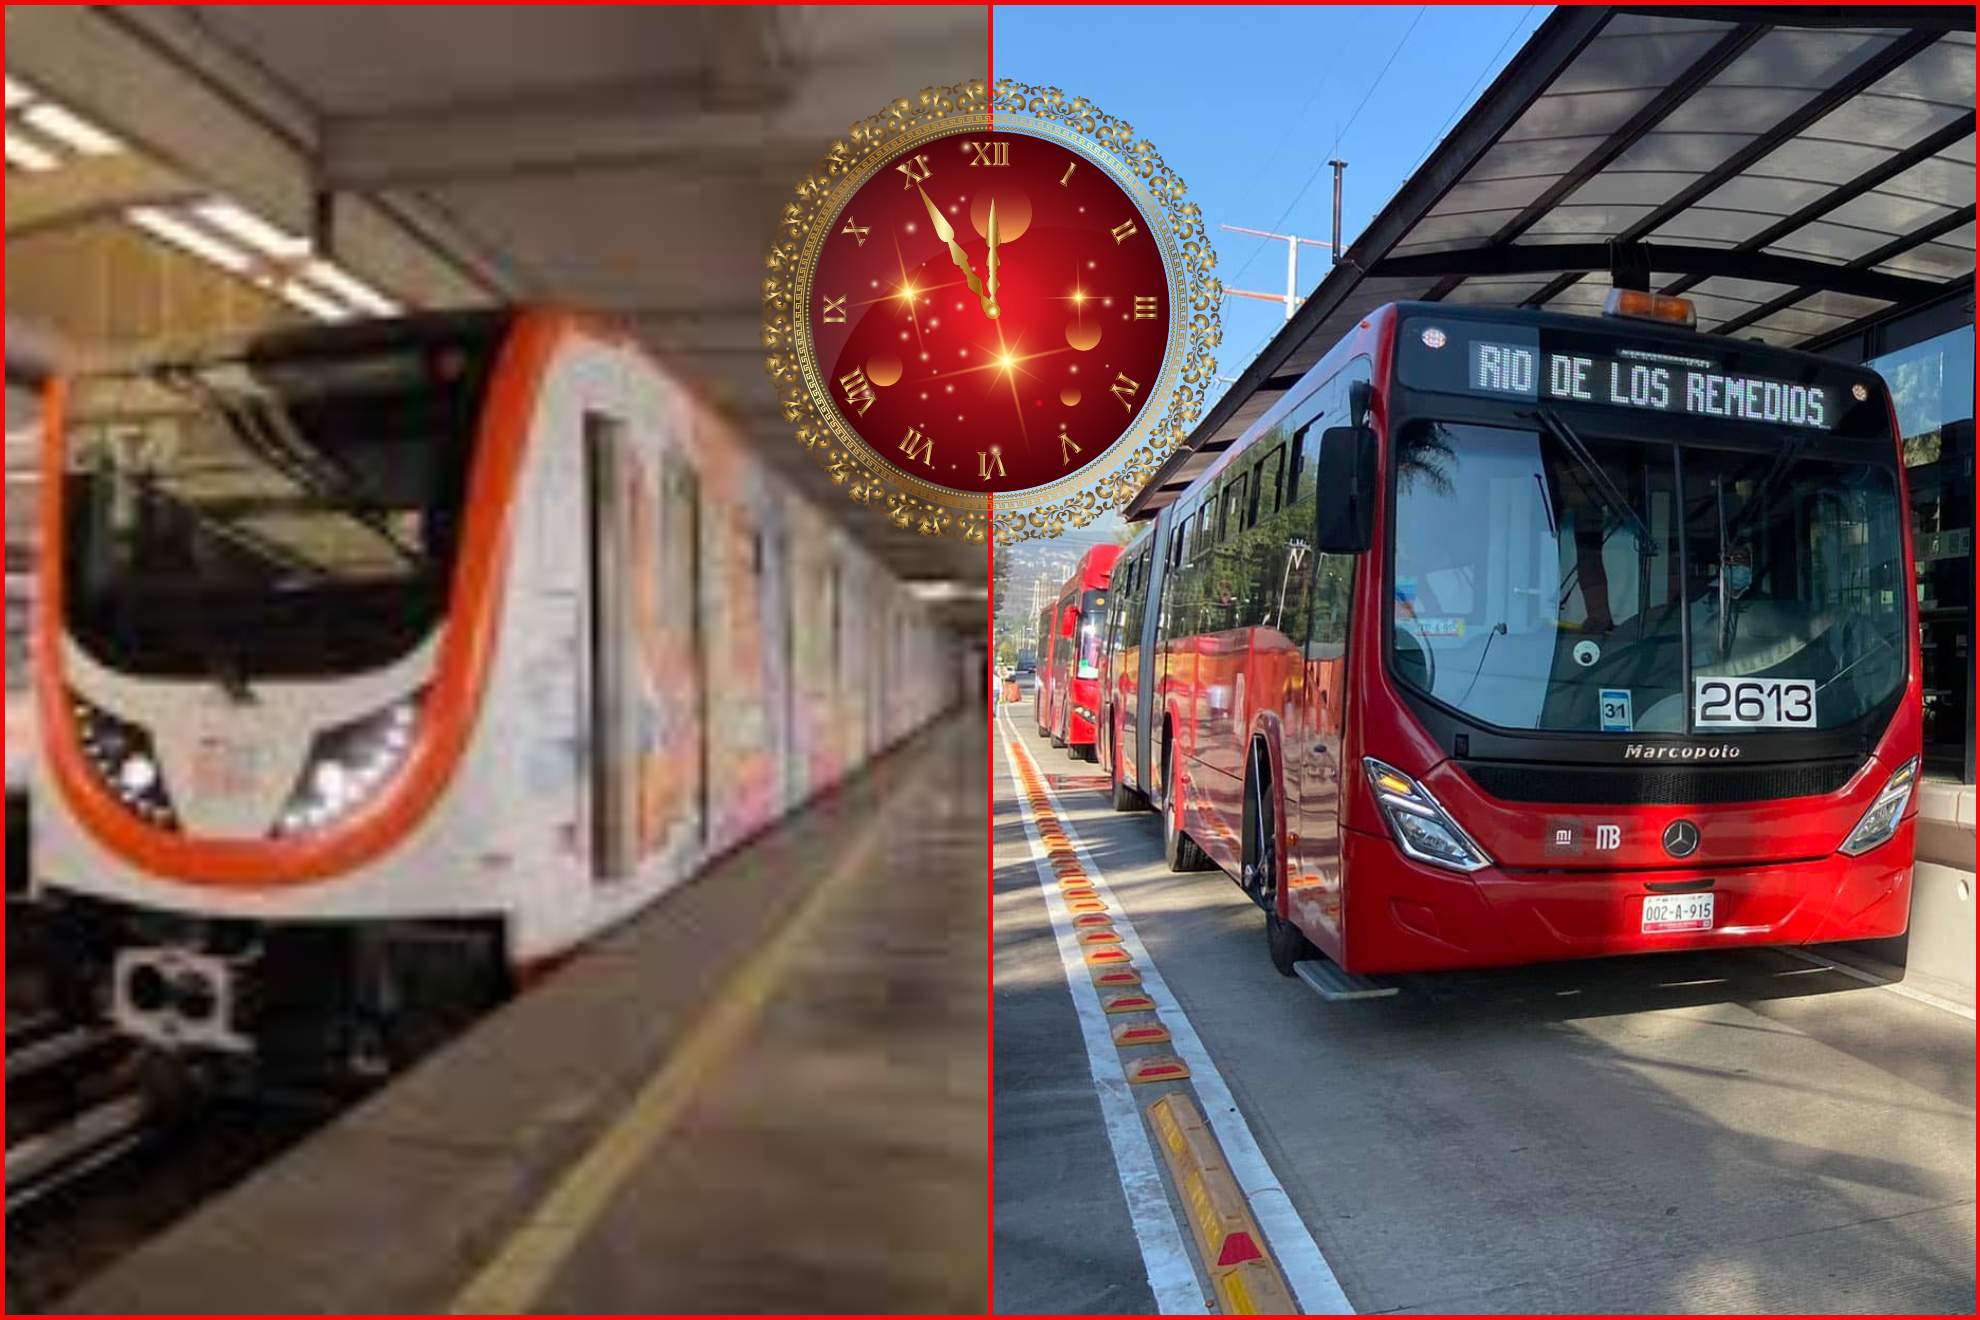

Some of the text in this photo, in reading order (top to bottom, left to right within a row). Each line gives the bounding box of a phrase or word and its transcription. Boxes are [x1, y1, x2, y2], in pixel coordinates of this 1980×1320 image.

[1478, 343, 1824, 426] RIO DE LOS REMEDIOS
[1604, 703, 1626, 719] 31
[1701, 682, 1812, 722] 2613
[1624, 744, 1740, 759] Marcopolo
[1646, 903, 1711, 921] 002-A-915
